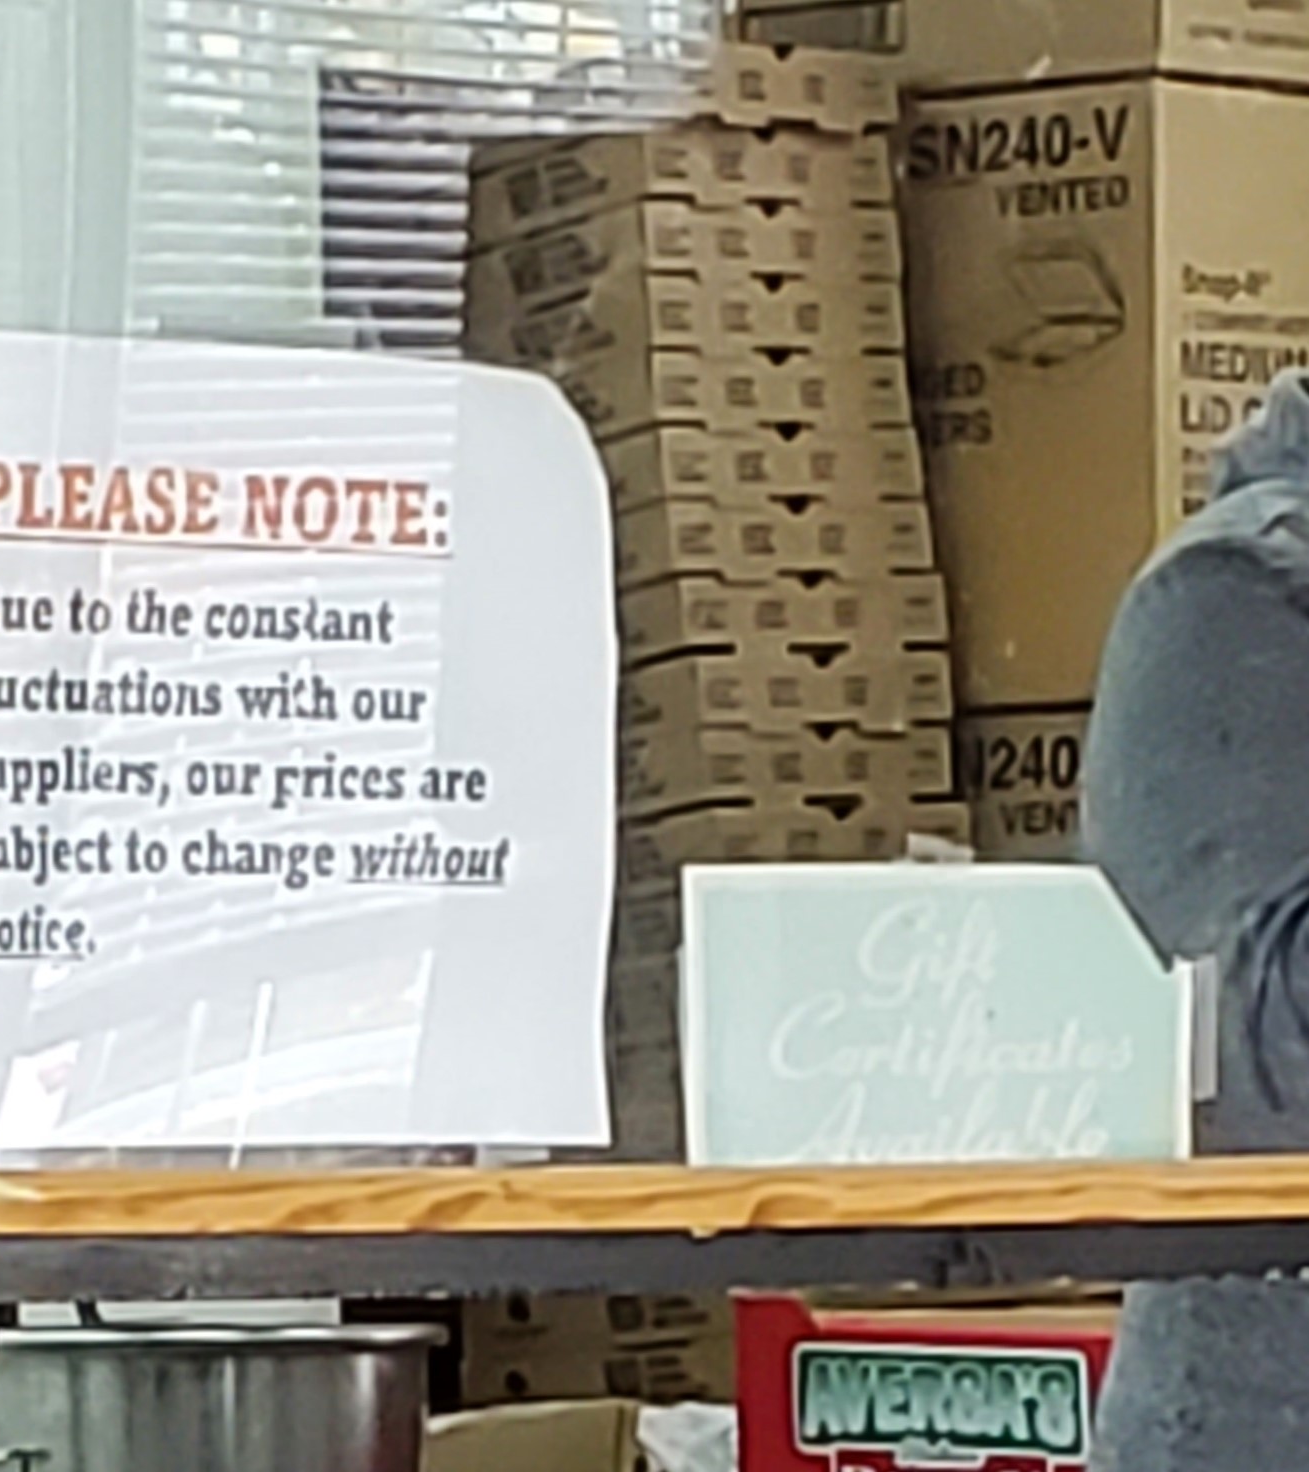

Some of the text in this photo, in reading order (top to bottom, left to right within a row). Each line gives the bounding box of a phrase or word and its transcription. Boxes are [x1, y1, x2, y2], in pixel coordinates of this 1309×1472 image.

[907, 103, 1130, 180] SN240-V
[994, 173, 1130, 217] VENTED
[242, 472, 452, 549] NOTE:
[68, 586, 113, 634] to
[126, 588, 193, 638] the
[204, 595, 396, 645] constant
[236, 670, 339, 723] with
[352, 684, 428, 724] our
[185, 757, 262, 797] our
[272, 750, 407, 810] prices
[419, 765, 488, 804] are
[124, 828, 169, 876] to
[180, 830, 336, 890] change
[350, 831, 512, 881] without
[856, 899, 1002, 1008] Gift
[769, 990, 1135, 1098] Certificates
